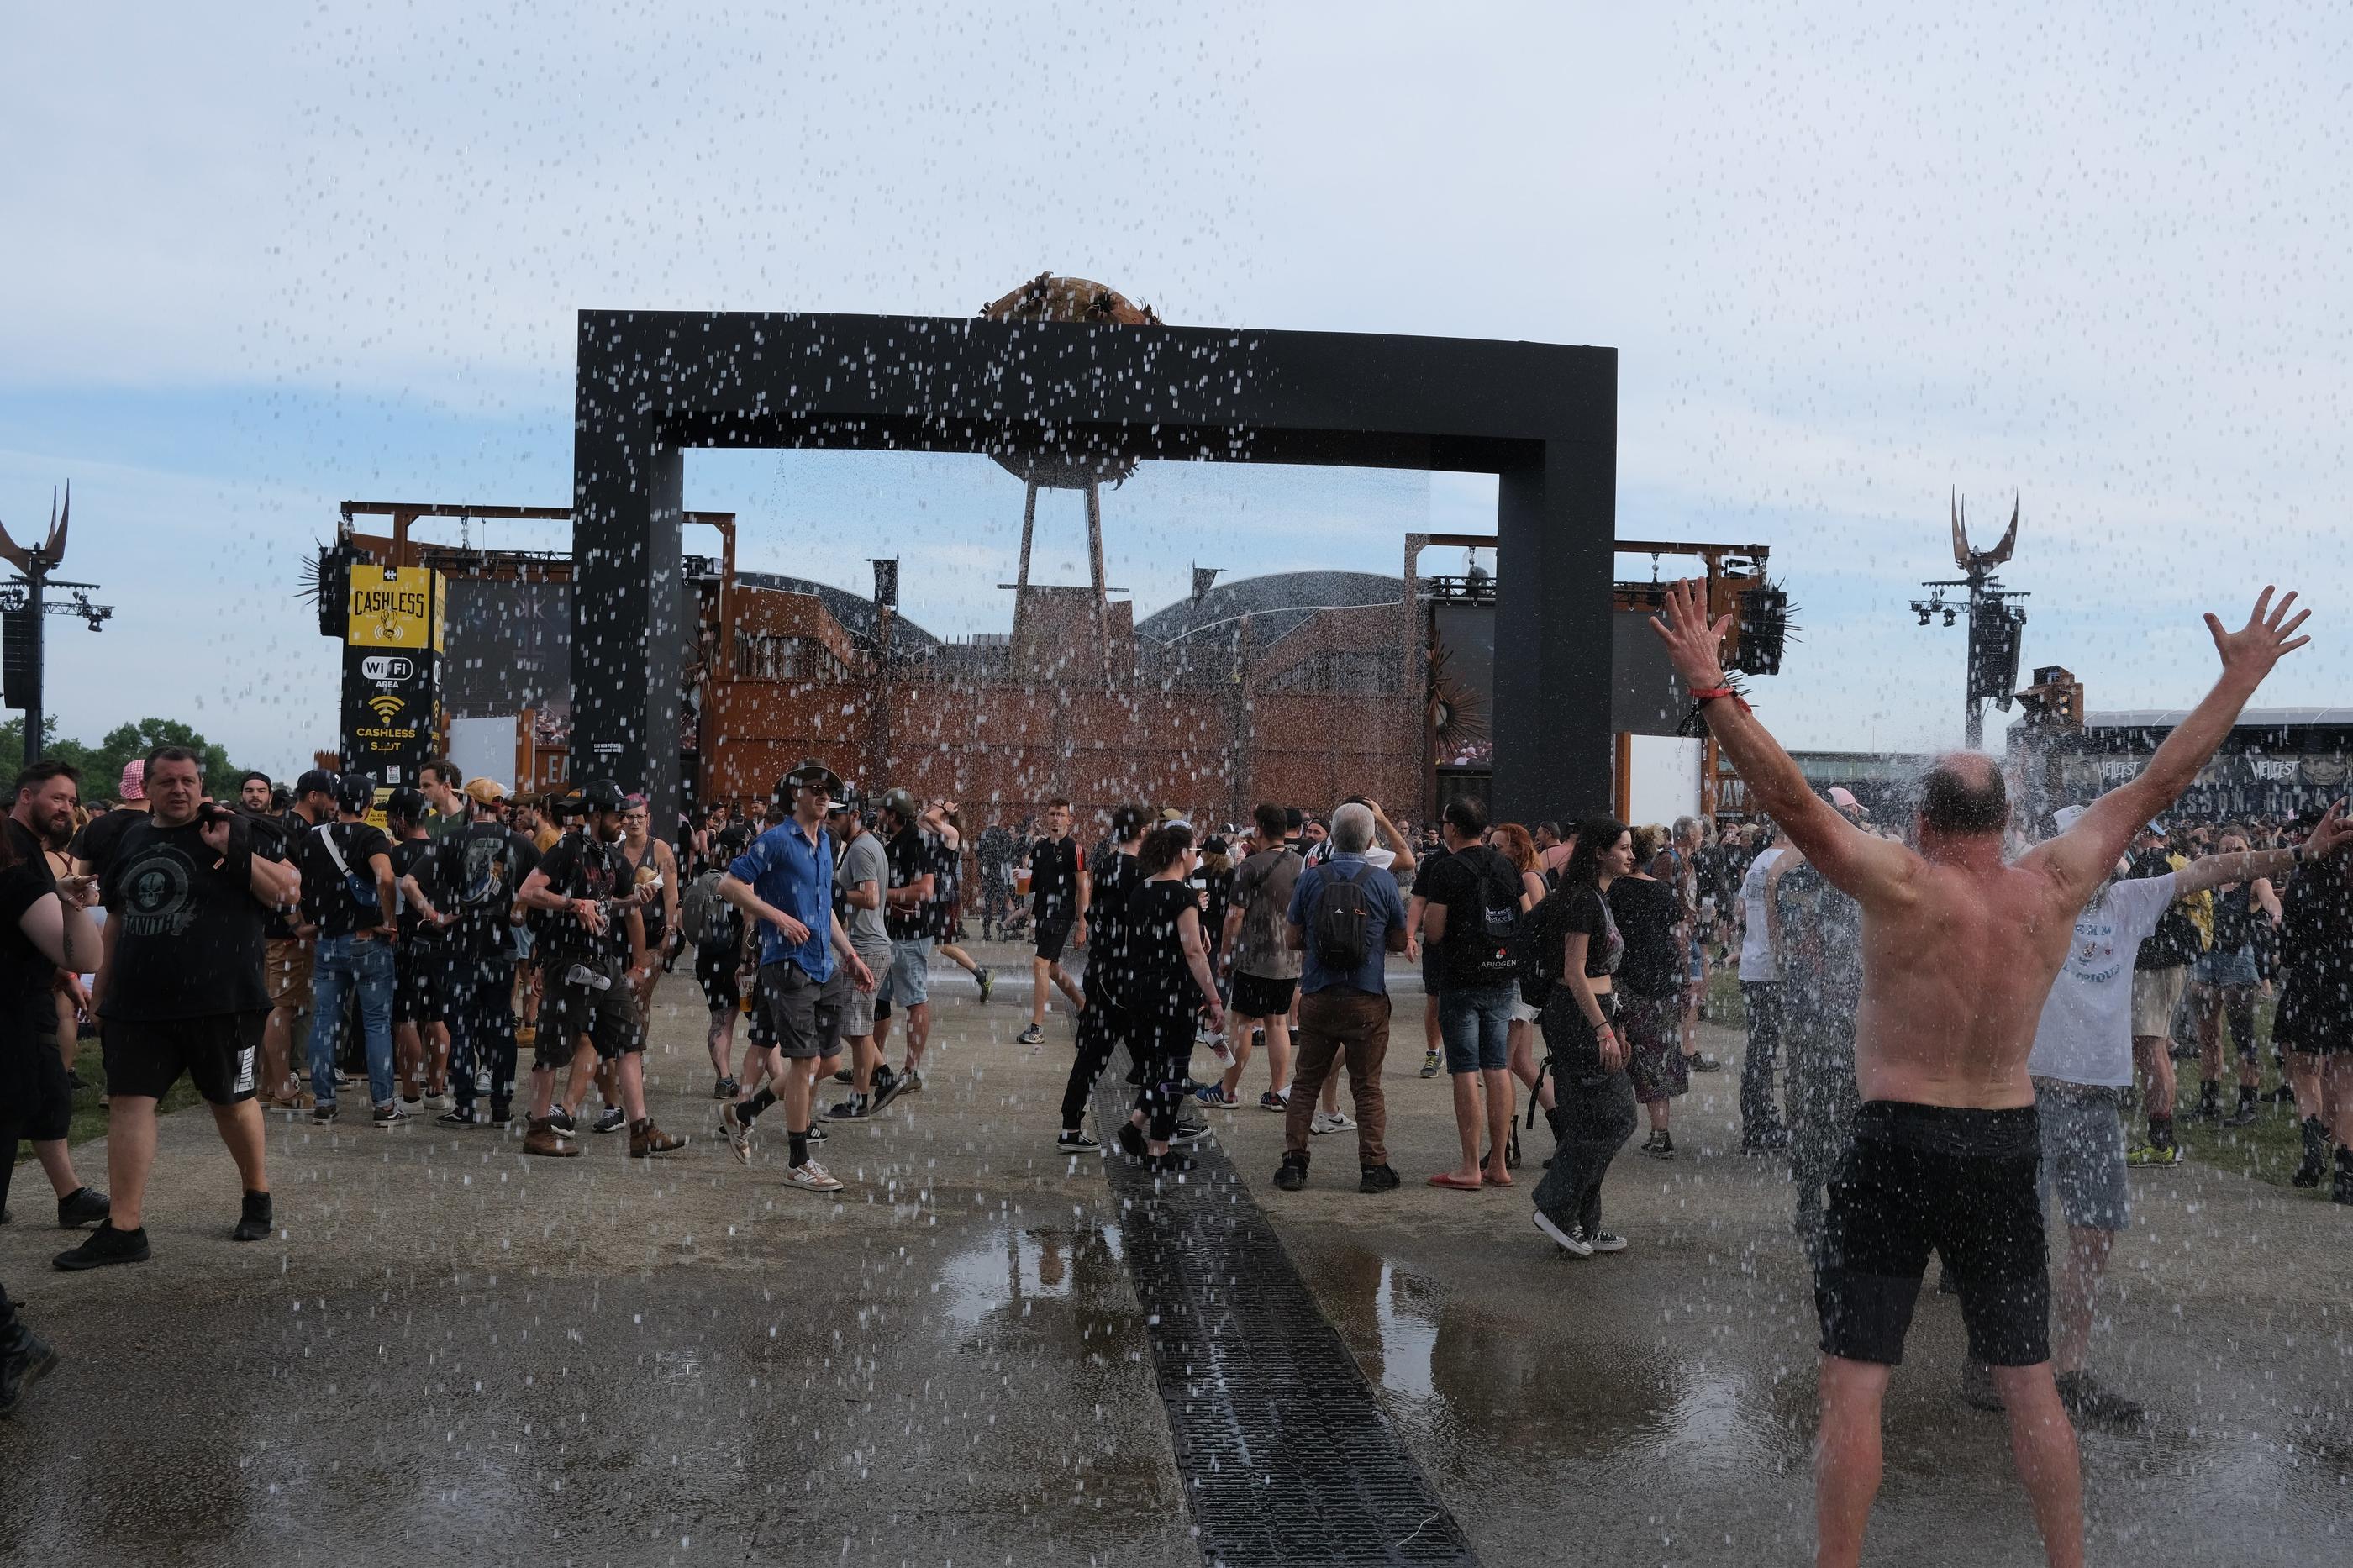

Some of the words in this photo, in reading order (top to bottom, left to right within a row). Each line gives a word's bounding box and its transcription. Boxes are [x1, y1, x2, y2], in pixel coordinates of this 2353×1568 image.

[355, 591, 424, 618] CASHLESS
[356, 728, 416, 738] CASHLESS
[371, 742, 401, 751] ST
[548, 755, 570, 784] EA
[2096, 760, 2141, 781] HELLFEST
[2251, 759, 2301, 781] HELLFEST
[1480, 960, 1517, 968] ABIOGEN
